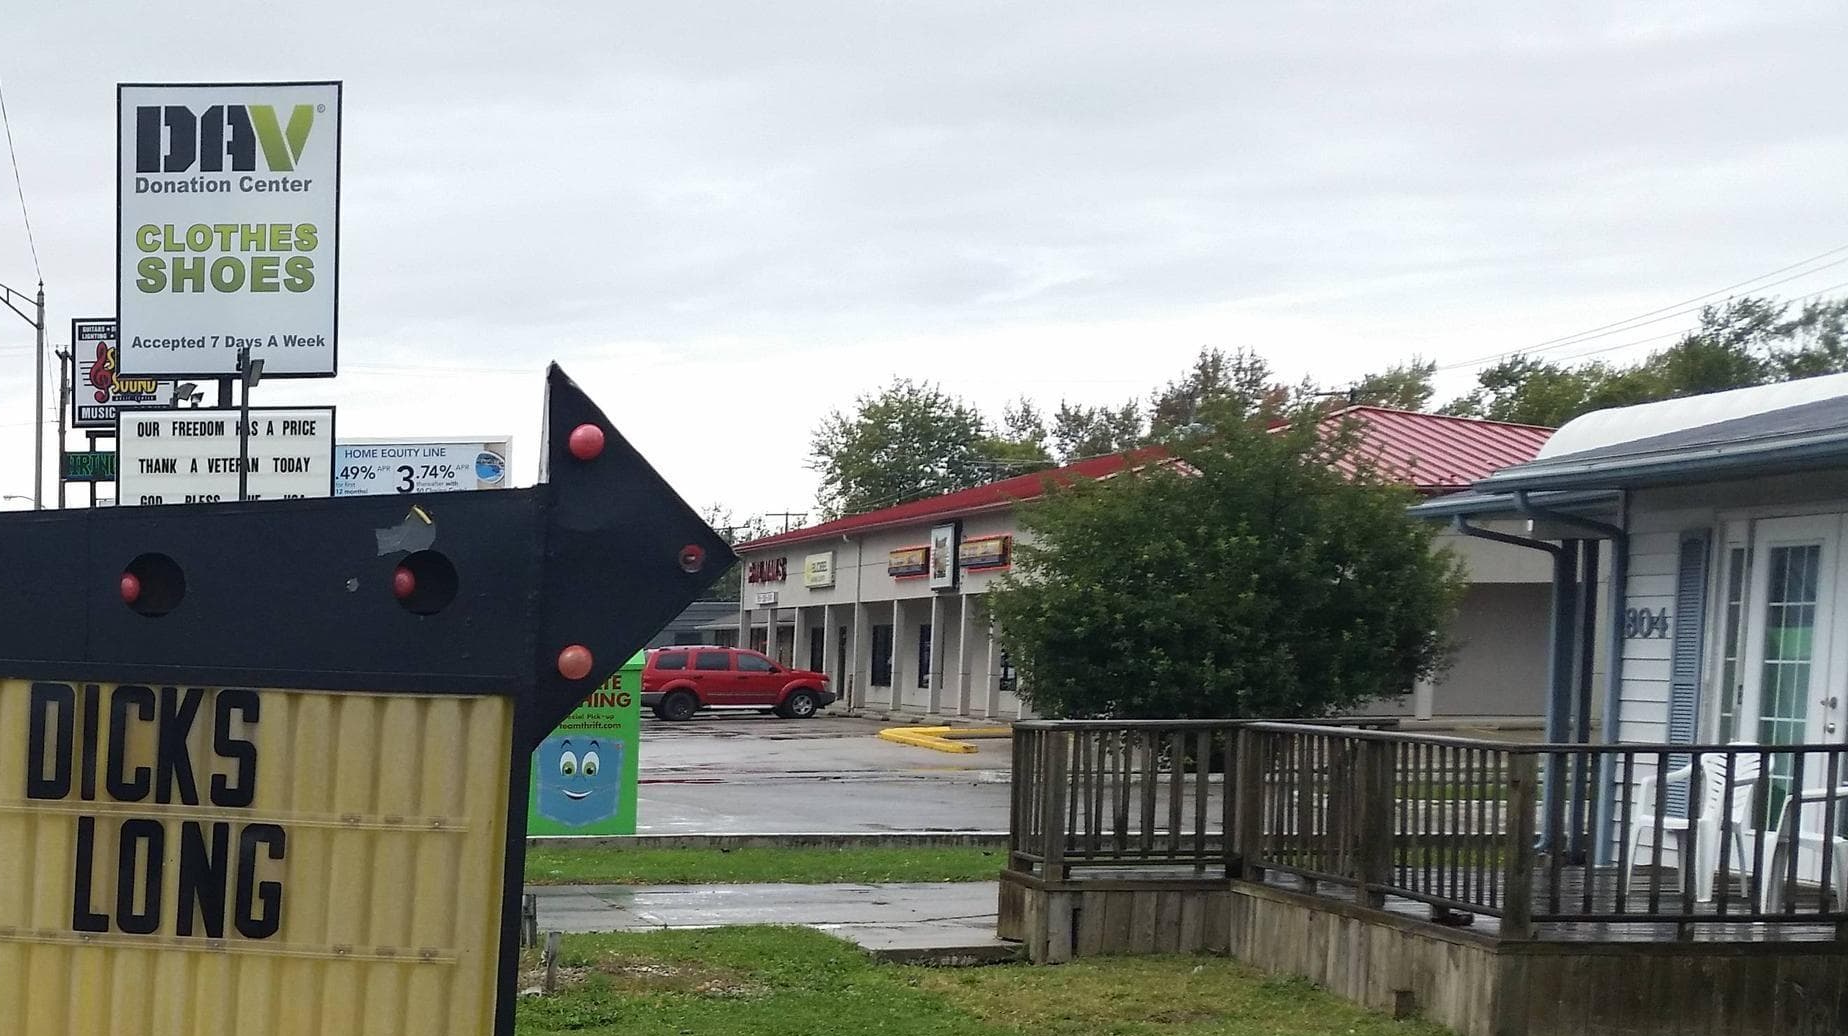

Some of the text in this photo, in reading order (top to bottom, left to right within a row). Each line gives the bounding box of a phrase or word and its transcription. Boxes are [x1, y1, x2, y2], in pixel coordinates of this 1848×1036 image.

[136, 104, 314, 173] DAV
[135, 175, 312, 194] Donation Center
[136, 223, 319, 253] CLOTHES
[136, 256, 316, 293] SHOES
[131, 335, 325, 351] Accepted 7 Days A Week
[81, 407, 116, 419] MUSIC
[137, 420, 316, 437] OUR FREEDOM HS A PRICE
[344, 448, 446, 458] HOME EQUITY LINE
[139, 459, 177, 473] THANK
[190, 459, 198, 473] A
[273, 457, 310, 472] TODAY
[27, 683, 260, 807] DICKS
[73, 816, 287, 940] LONG
